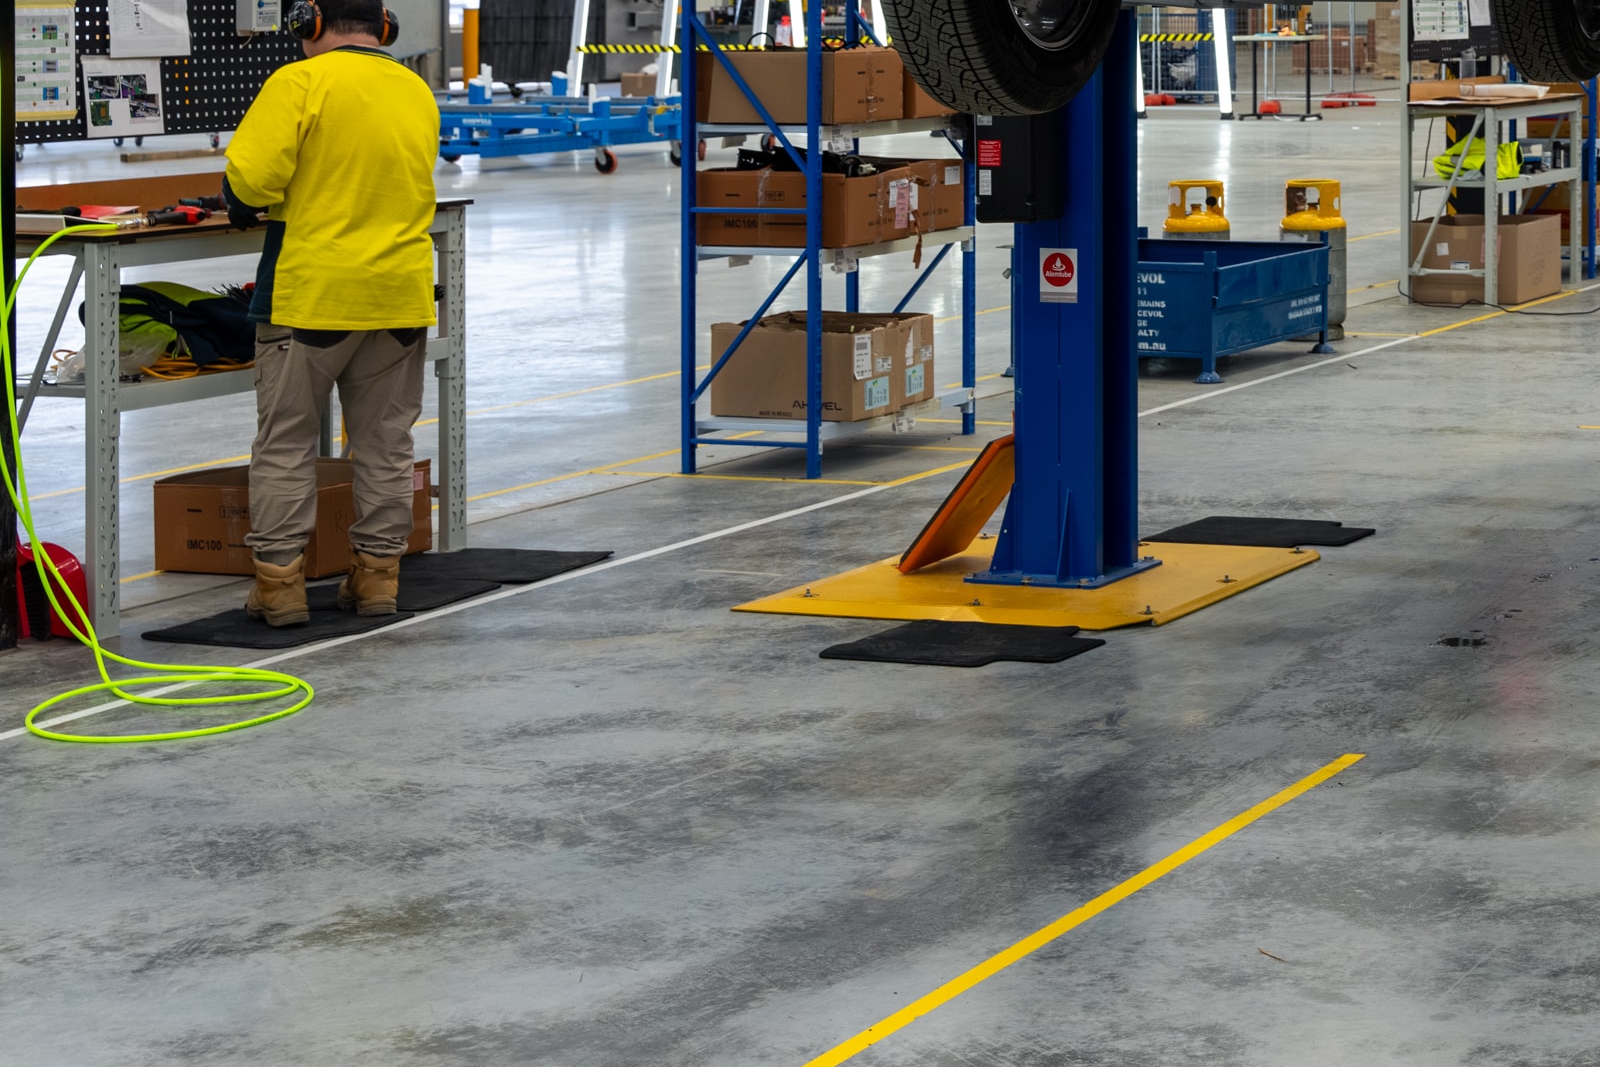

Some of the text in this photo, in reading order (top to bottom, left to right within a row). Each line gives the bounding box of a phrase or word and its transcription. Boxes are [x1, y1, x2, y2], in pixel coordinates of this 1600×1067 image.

[725, 219, 758, 228] IMC100
[1045, 270, 1072, 278] Alemlube
[186, 539, 222, 551] IMC100
